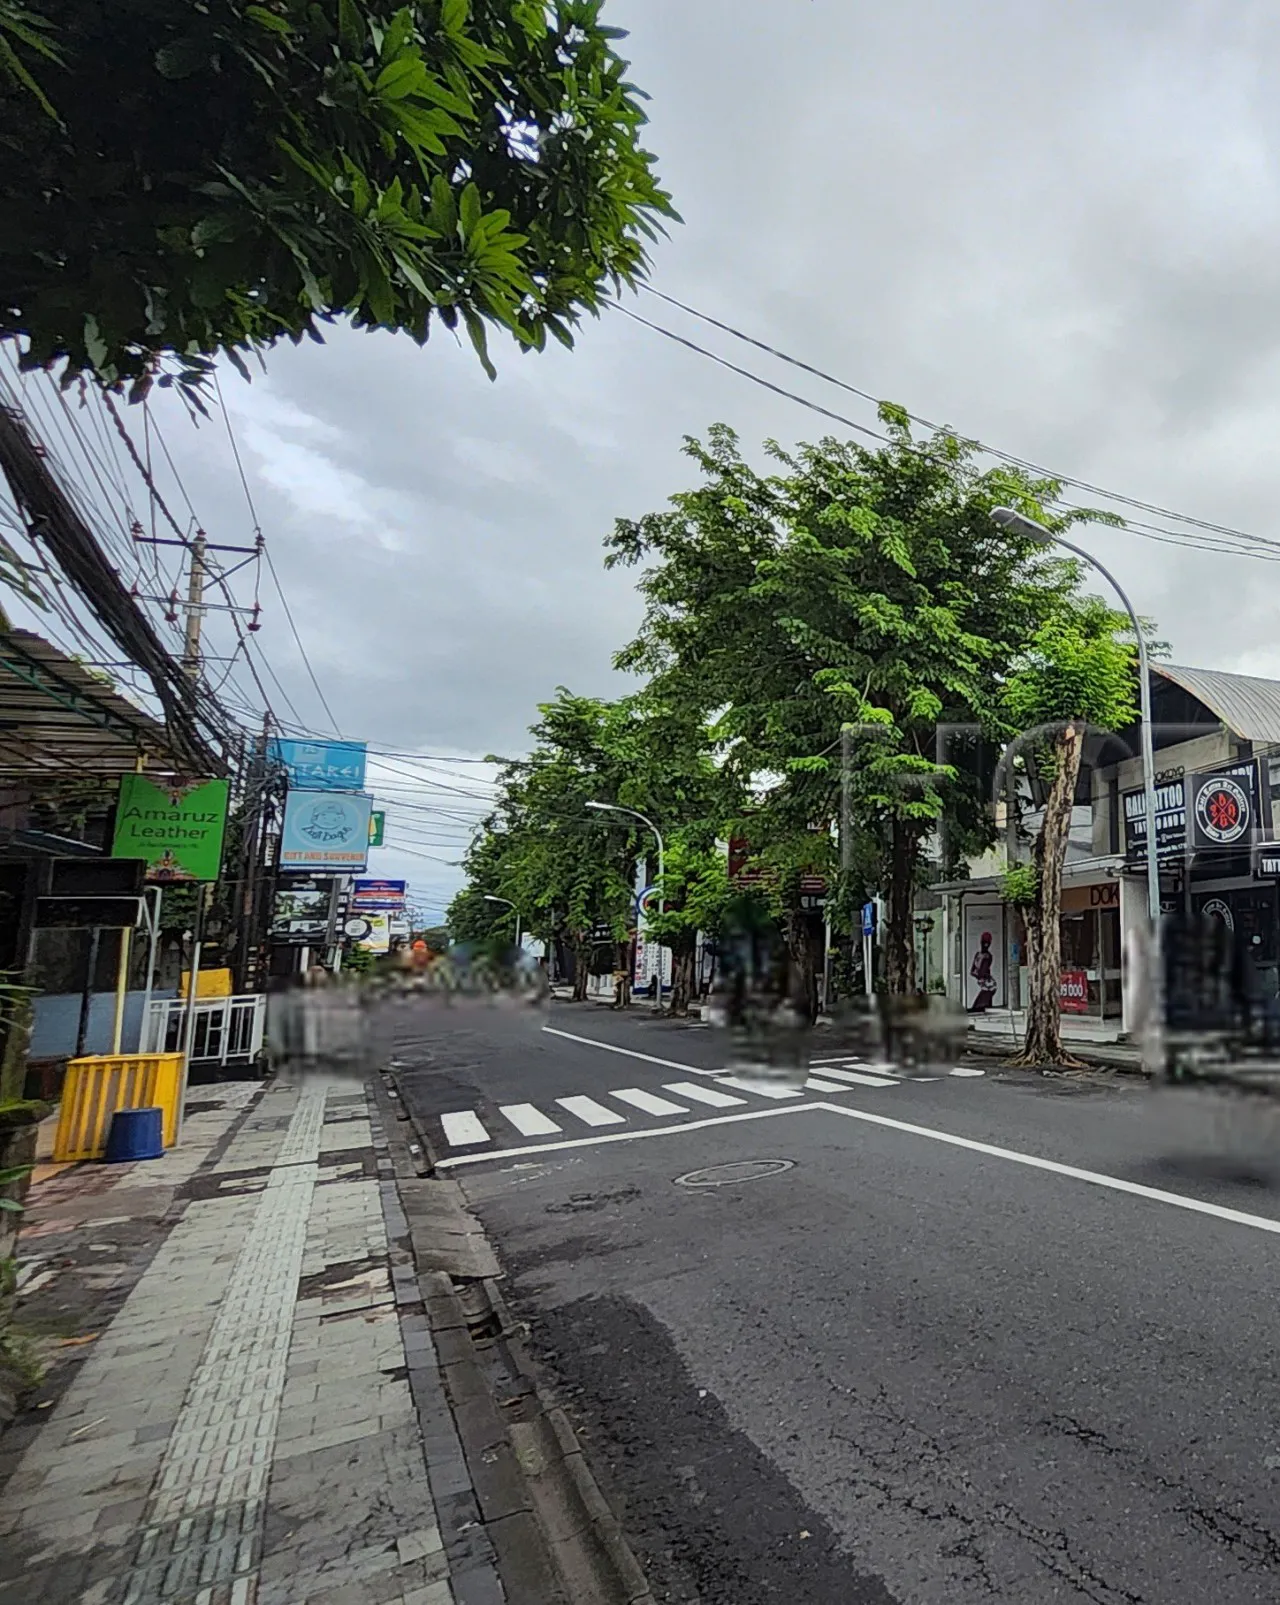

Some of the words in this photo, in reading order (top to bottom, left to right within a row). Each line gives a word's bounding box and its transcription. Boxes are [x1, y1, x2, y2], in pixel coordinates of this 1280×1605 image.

[1152, 783, 1184, 813] ATTOO
[123, 807, 219, 824] Amaruz
[130, 823, 210, 840] Leather
